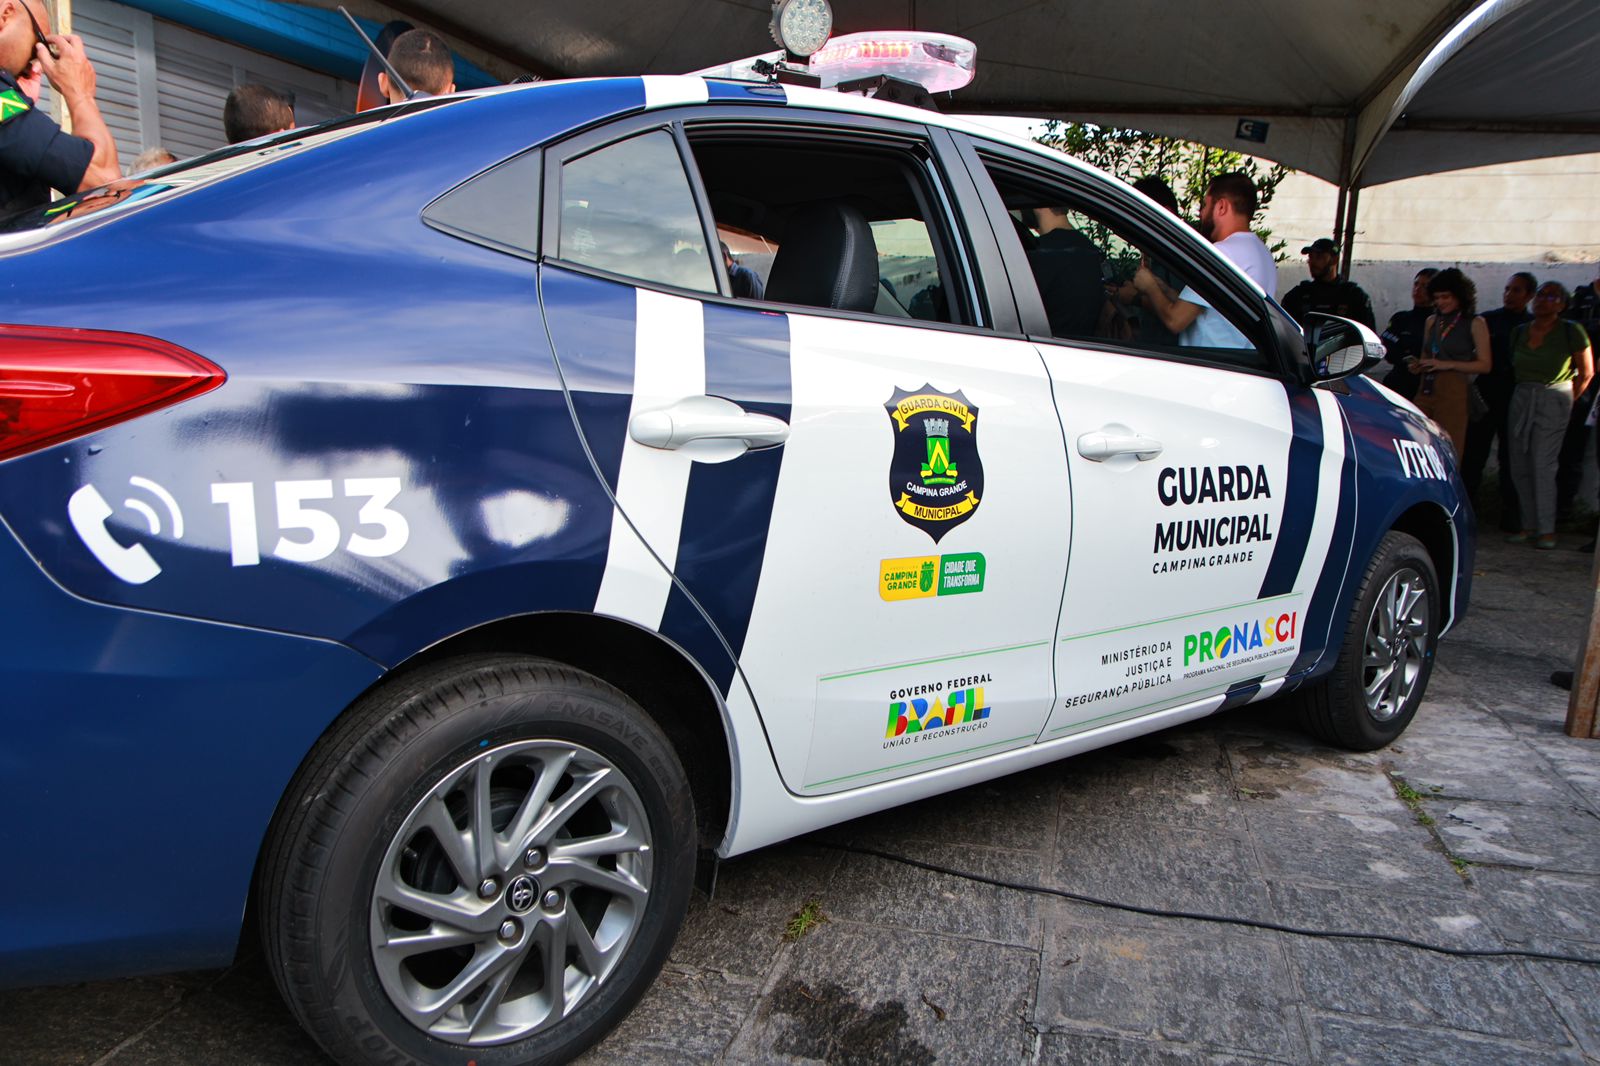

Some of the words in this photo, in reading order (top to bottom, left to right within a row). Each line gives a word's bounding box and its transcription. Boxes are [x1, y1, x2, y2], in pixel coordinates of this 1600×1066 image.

[900, 398, 942, 415] GUARDA
[942, 400, 967, 417] CIVIL
[1392, 438, 1435, 479] VTR
[906, 481, 939, 497] CAMPINA
[939, 480, 968, 497] GRANDE
[1157, 464, 1272, 507] GUARDA
[210, 477, 410, 567] 153
[914, 505, 962, 519] MUNICIPAL
[1153, 513, 1273, 554] MUNICIPAL
[944, 561, 965, 574] CIDADE
[965, 560, 977, 573] QUE
[1152, 556, 1206, 574] CAMPINA
[1208, 551, 1254, 567] GRANDE
[884, 570, 918, 582] CAMPINA
[887, 580, 917, 591] GRANDE
[943, 573, 980, 588] TRANSFORMA
[1183, 611, 1297, 667] PRONASCI
[1101, 643, 1158, 666] MINISTÉRIO
[1160, 640, 1172, 652] DA
[1125, 659, 1165, 678] JUSTIÇA
[1166, 656, 1172, 667] E
[1183, 669, 1206, 679] PROGRAMA
[1206, 664, 1226, 673] NACIONAL
[890, 682, 943, 700] GOVERNO
[947, 673, 993, 690] FEDERAL
[1065, 684, 1129, 709] SEGURANÇA
[1131, 673, 1172, 692] PÚBLICA
[884, 687, 992, 739] BRASIL
[882, 736, 911, 749] UNIÃO
[913, 735, 919, 743] E
[922, 721, 988, 741] RECONSTRUÇÃO
